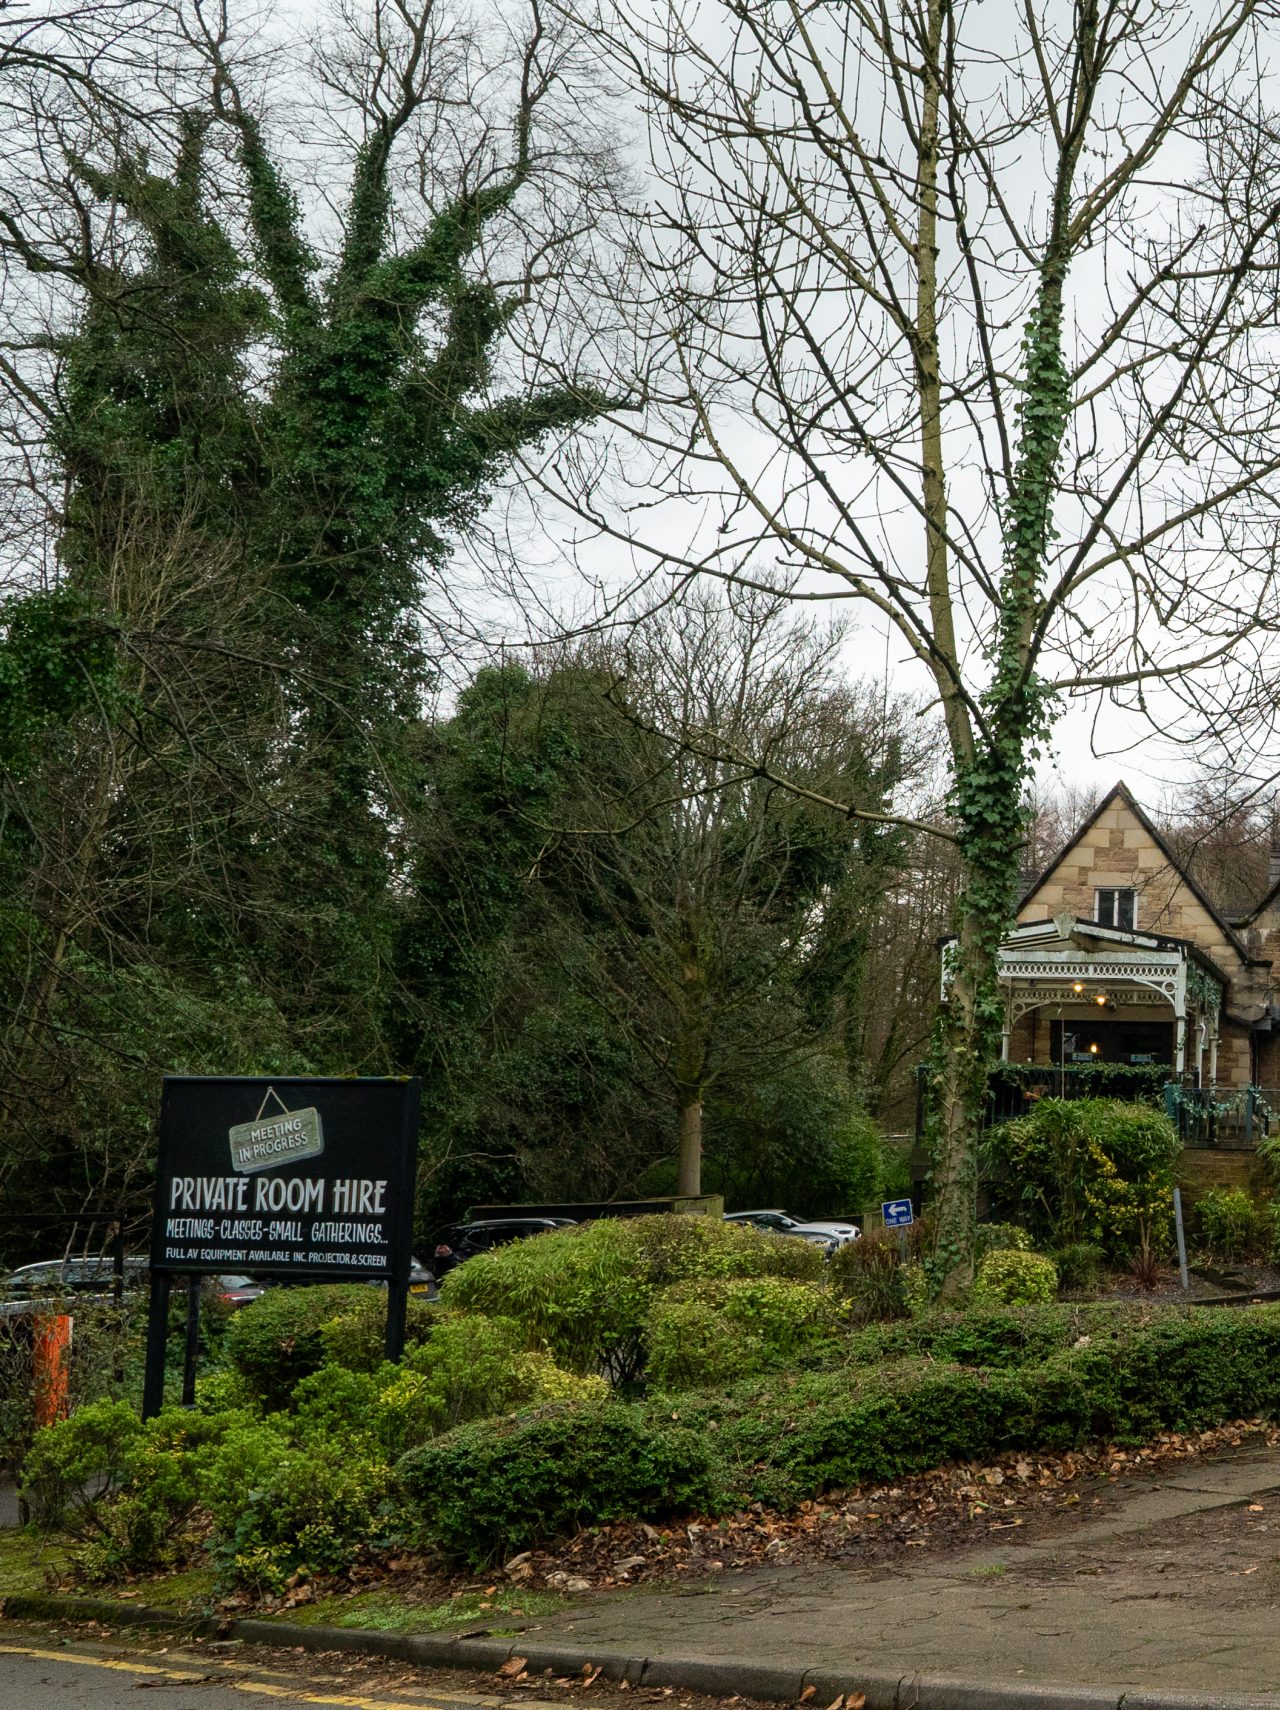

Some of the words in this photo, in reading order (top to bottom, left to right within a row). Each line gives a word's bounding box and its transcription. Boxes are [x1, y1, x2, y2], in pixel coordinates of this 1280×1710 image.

[251, 1119, 302, 1142] MEETING
[239, 1147, 251, 1162] IN
[253, 1131, 308, 1158] PROGRESS
[169, 1177, 250, 1211] PRIVATE
[255, 1178, 325, 1213] ROOM
[333, 1179, 388, 1214] HIRE
[886, 1217, 897, 1225] ONE
[899, 1215, 911, 1223] WAY
[166, 1247, 185, 1259] FULL
[186, 1248, 199, 1259] AV
[200, 1249, 248, 1260] EQUIPMENT
[248, 1250, 290, 1261] AVAILABLE
[308, 1252, 351, 1265] PROJECTOR
[358, 1254, 387, 1267] SCREEN
